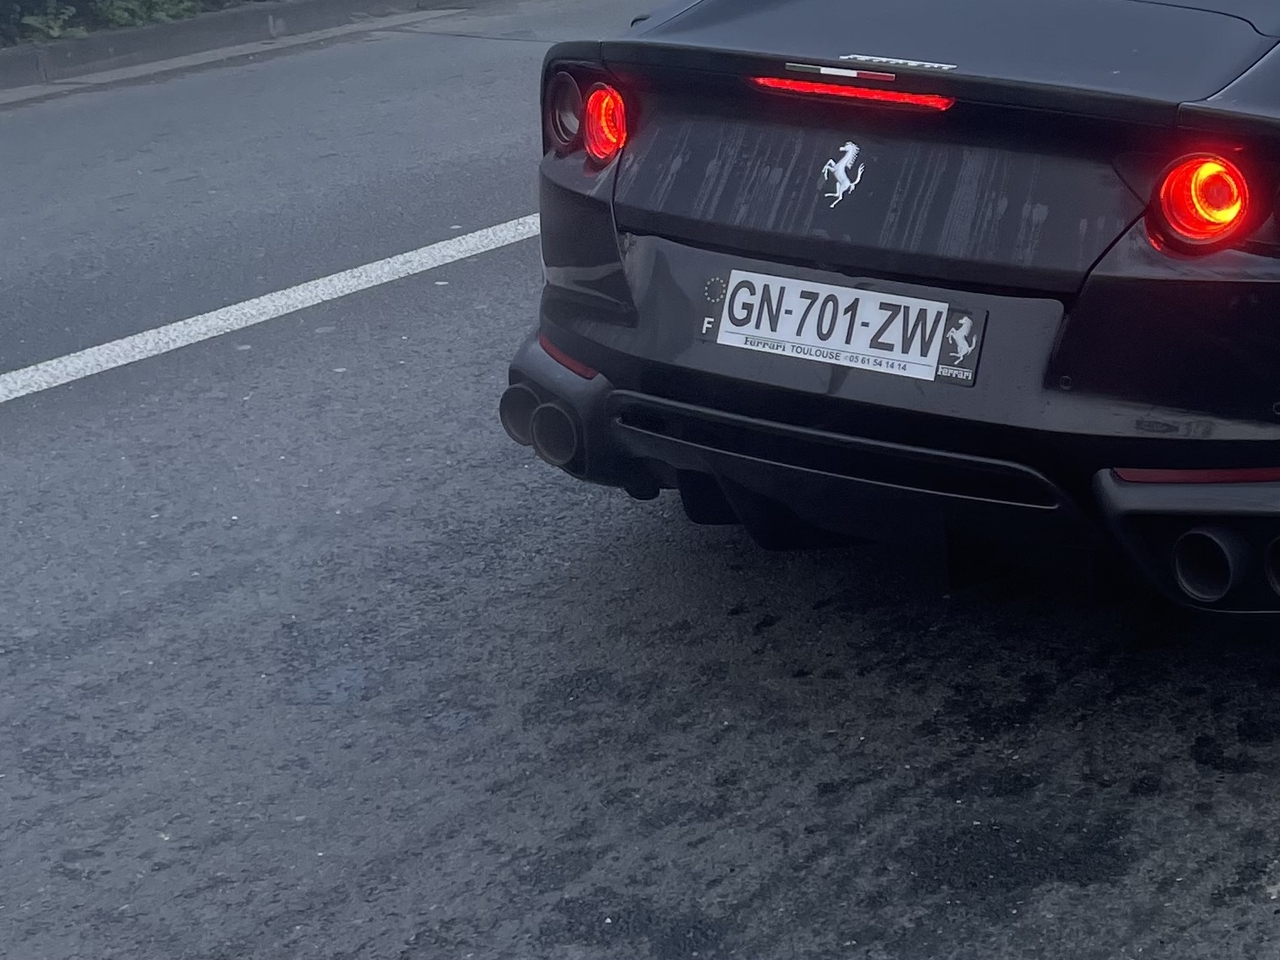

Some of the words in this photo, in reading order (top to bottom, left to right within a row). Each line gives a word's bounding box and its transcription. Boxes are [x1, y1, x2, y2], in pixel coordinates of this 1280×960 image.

[702, 316, 715, 334] F
[727, 280, 944, 358] GN-701-ZW
[743, 336, 786, 352] Ferrari
[790, 344, 841, 361] TOULOUSE
[848, 355, 860, 364] 05
[860, 356, 871, 365] 61
[872, 358, 883, 368] 54
[885, 360, 895, 370] 14
[897, 362, 907, 371] 14
[937, 364, 973, 380] Ferrari
